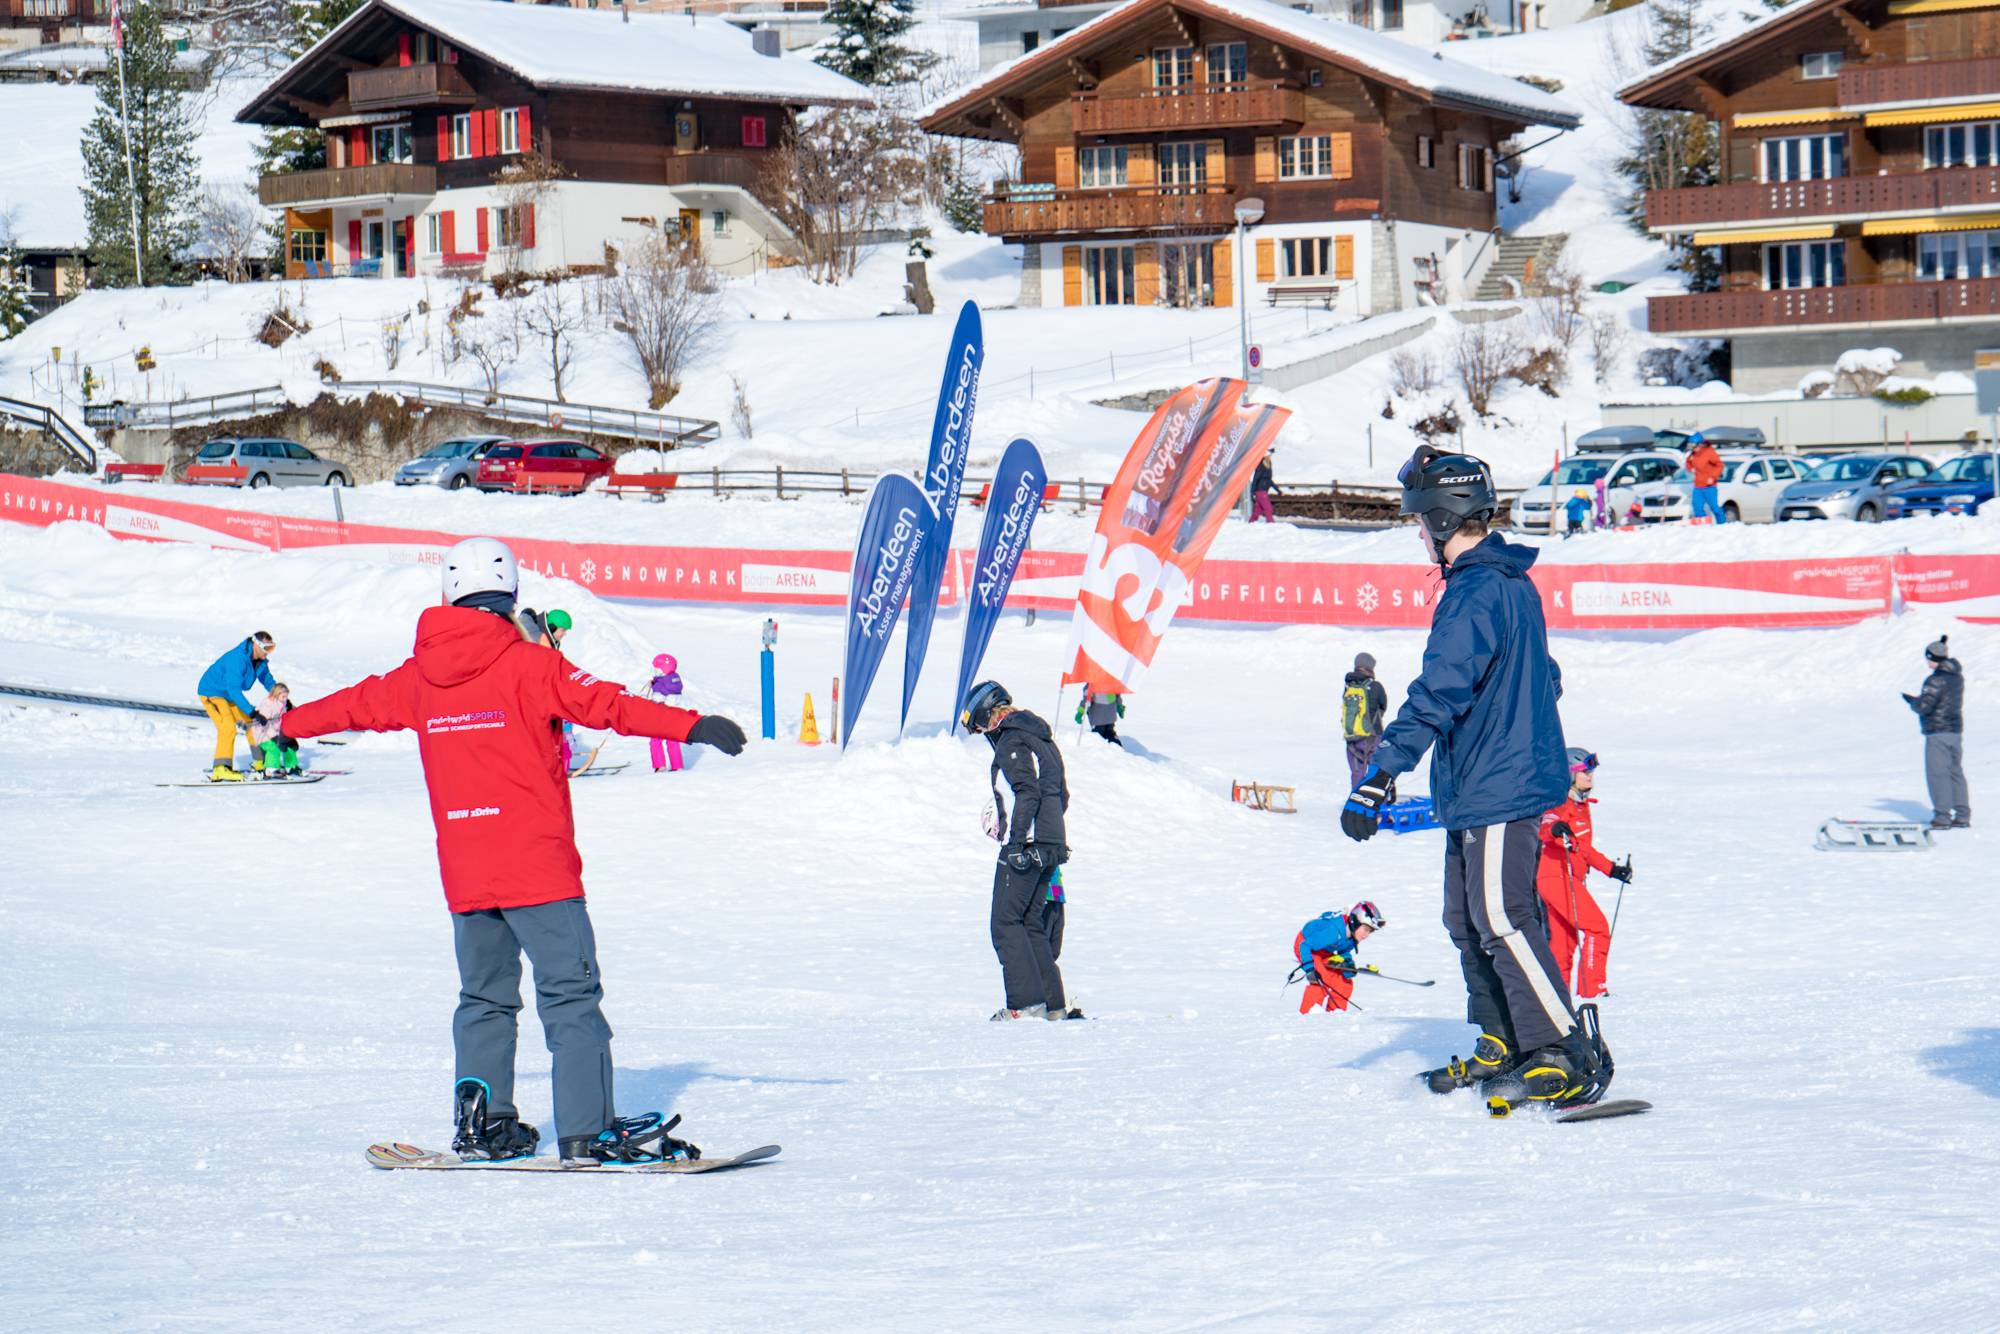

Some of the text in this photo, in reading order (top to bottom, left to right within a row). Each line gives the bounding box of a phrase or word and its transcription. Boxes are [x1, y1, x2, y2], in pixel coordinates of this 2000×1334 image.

[925, 343, 976, 514] Aberdeen
[945, 367, 980, 520] Asset management
[1137, 410, 1186, 494] Ragusa
[3, 491, 102, 523] SNOWPARK
[1437, 473, 1483, 484] SCOTT
[978, 470, 1035, 608] Aberdeen
[1006, 490, 1040, 569] management
[604, 564, 736, 586] SNOWPARK
[856, 506, 917, 638] Aberdeen
[876, 528, 926, 641] Asset management
[1200, 583, 1343, 606] OFFICIAL
[447, 809, 469, 820] BMW
